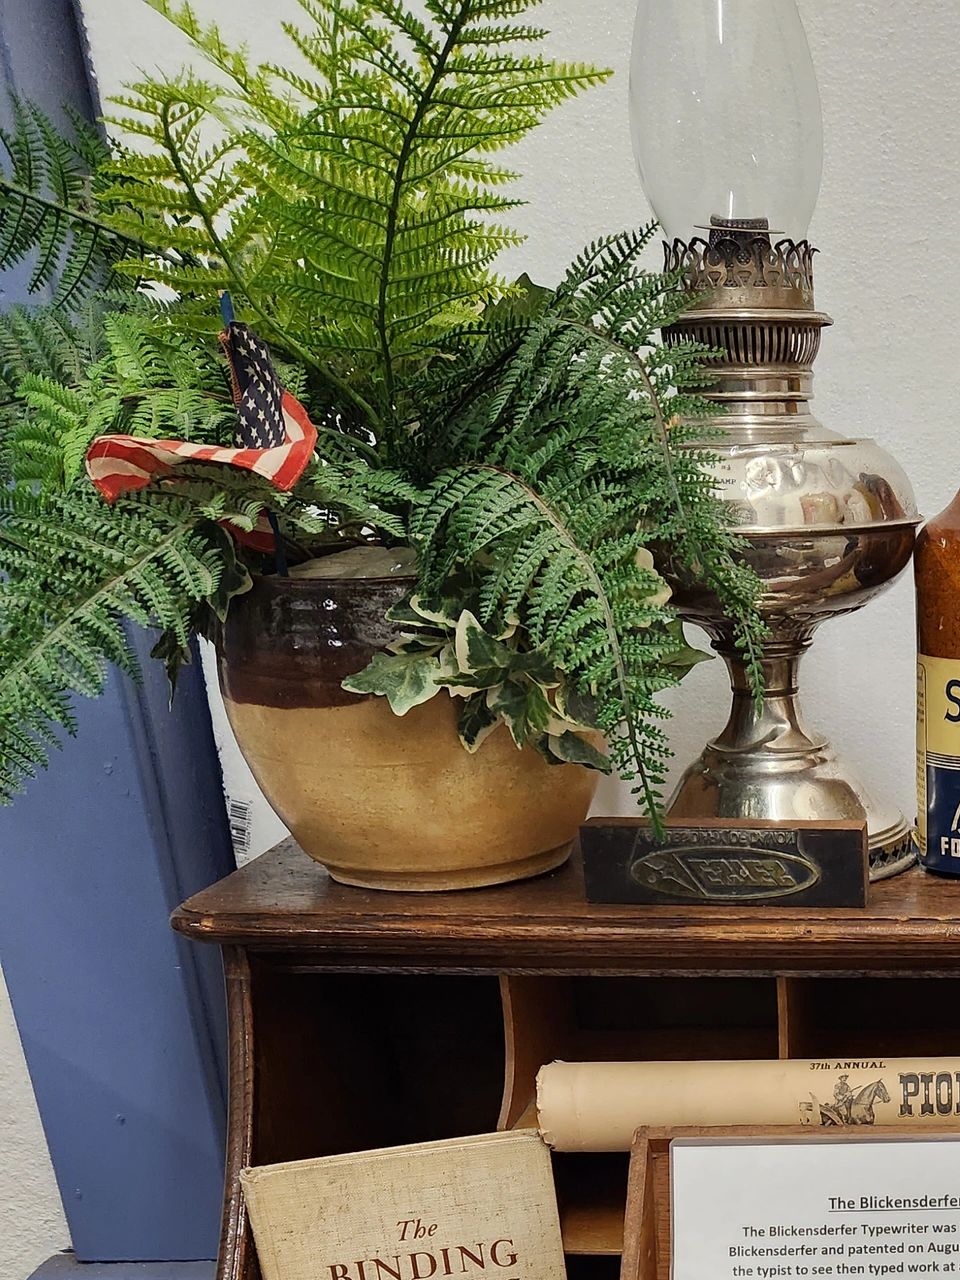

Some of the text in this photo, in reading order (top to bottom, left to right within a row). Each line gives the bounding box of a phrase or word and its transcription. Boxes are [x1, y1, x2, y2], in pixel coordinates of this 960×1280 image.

[809, 1060, 887, 1071] 37th ANNUAL
[828, 1197, 856, 1210] The
[396, 1219, 438, 1242] The
[741, 1225, 766, 1238] The
[769, 1223, 858, 1237] Blickensderfer
[860, 1222, 930, 1238] Typewriter
[932, 1224, 957, 1234] was
[729, 1244, 818, 1258] Blickensderfer
[821, 1243, 845, 1256] and
[848, 1241, 905, 1258] patented
[907, 1244, 924, 1254] on
